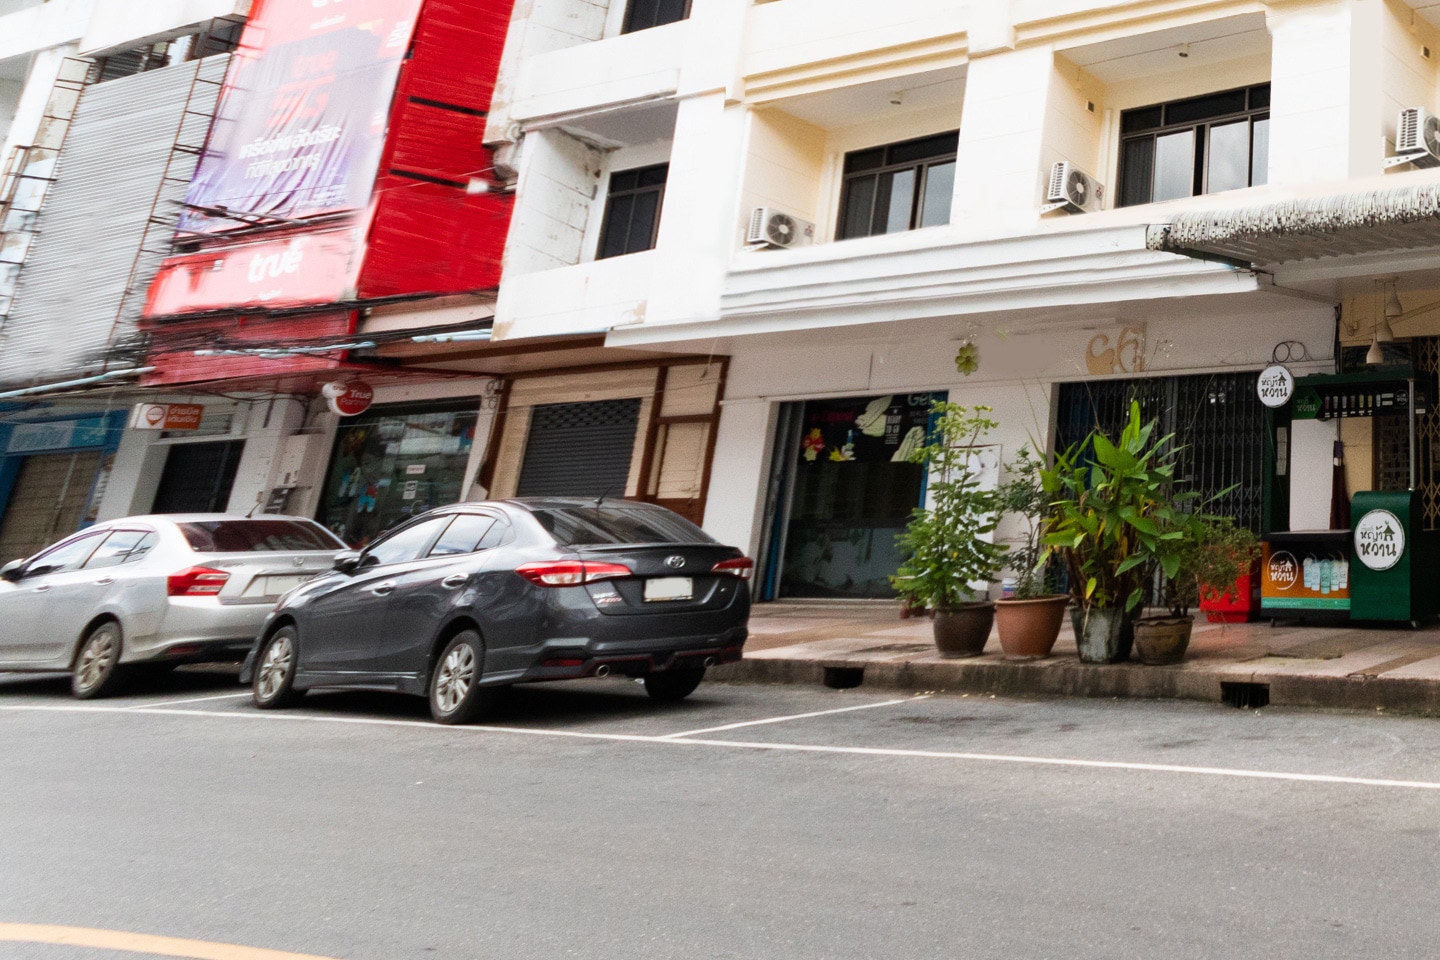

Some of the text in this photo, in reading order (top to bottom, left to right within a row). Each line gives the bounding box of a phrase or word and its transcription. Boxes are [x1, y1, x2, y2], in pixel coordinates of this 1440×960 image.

[247, 251, 303, 283] true
[350, 389, 372, 399] True
[1261, 387, 1288, 399] หวาน
[1360, 542, 1397, 557] หวาน
[1270, 571, 1294, 582] หวาน
